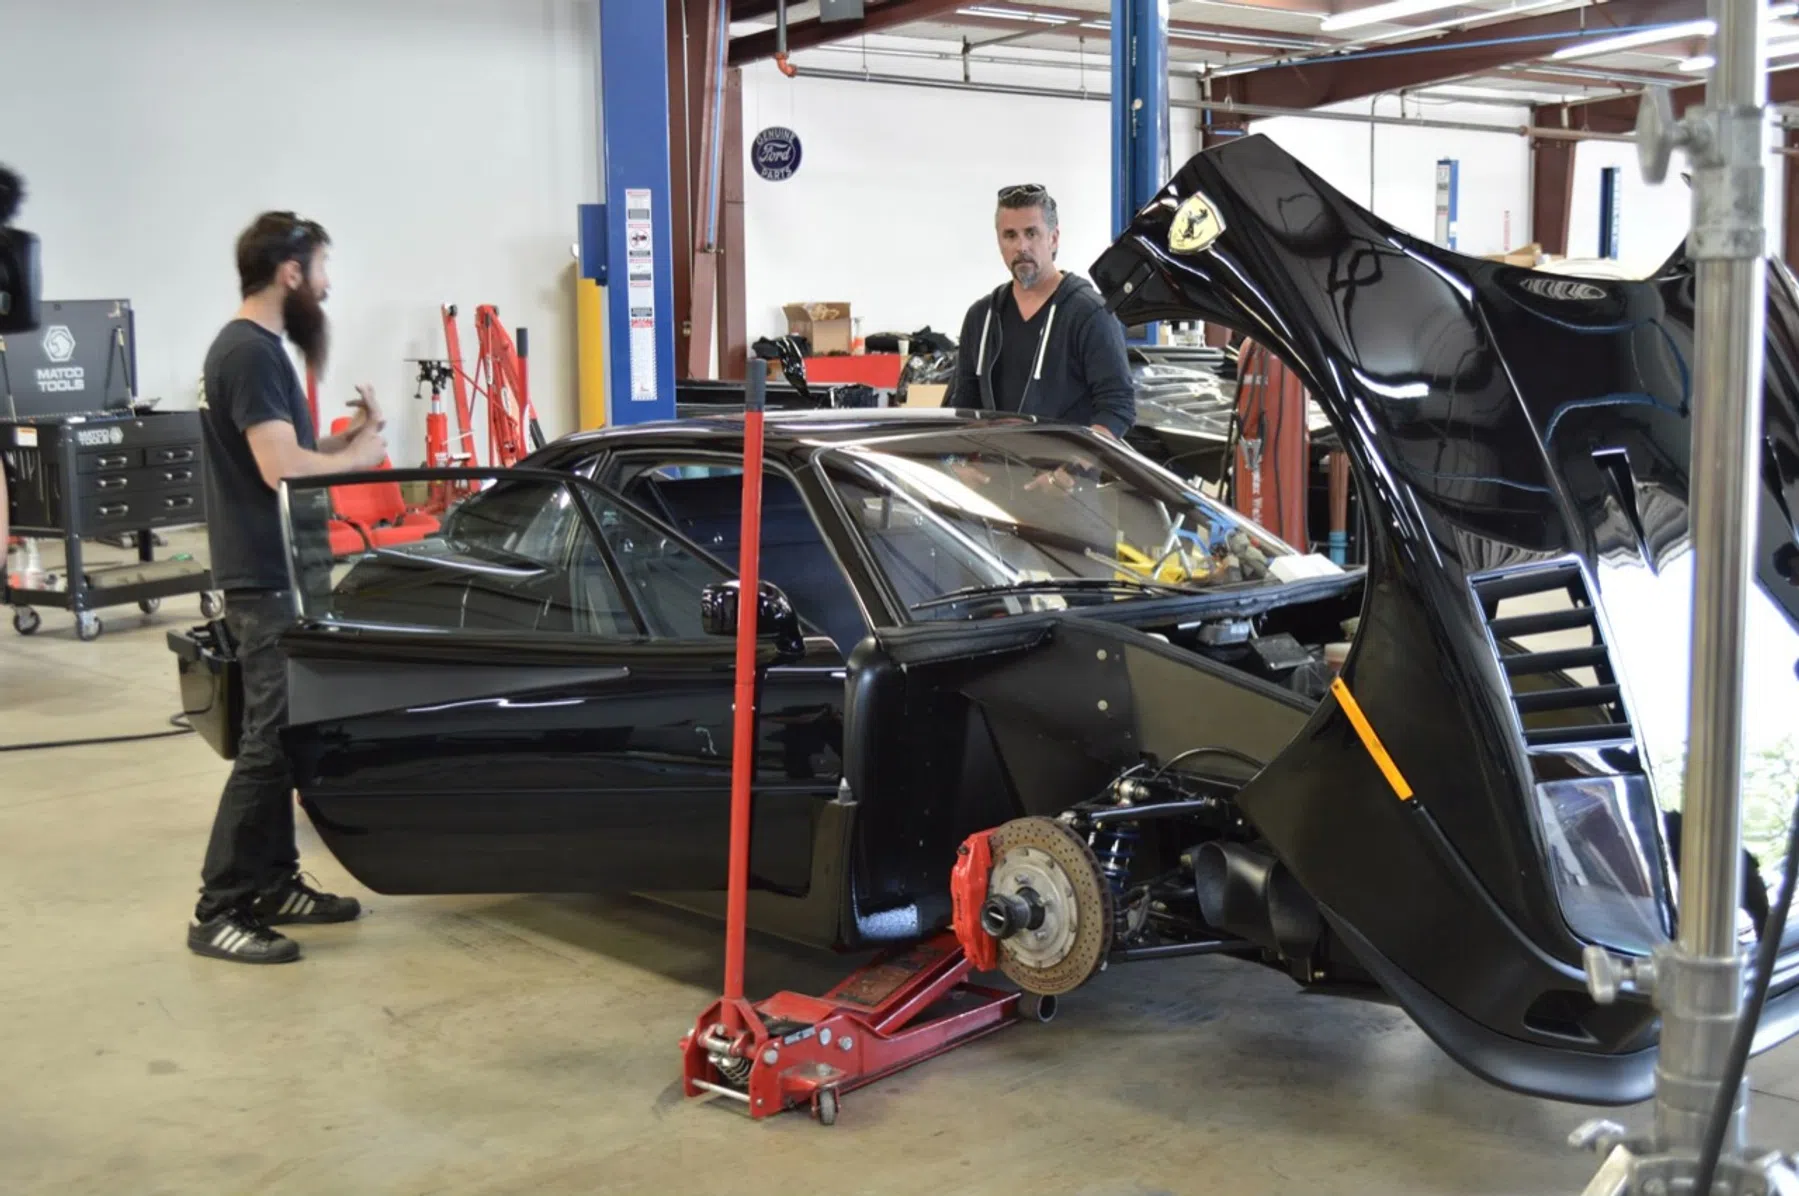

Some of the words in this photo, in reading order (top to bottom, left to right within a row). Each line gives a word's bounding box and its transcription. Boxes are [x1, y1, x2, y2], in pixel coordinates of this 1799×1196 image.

[757, 127, 796, 144] GENUINE
[759, 143, 791, 162] Ford
[761, 166, 792, 181] PARTS
[36, 367, 84, 380] MATCO
[37, 379, 85, 392] TOOLS
